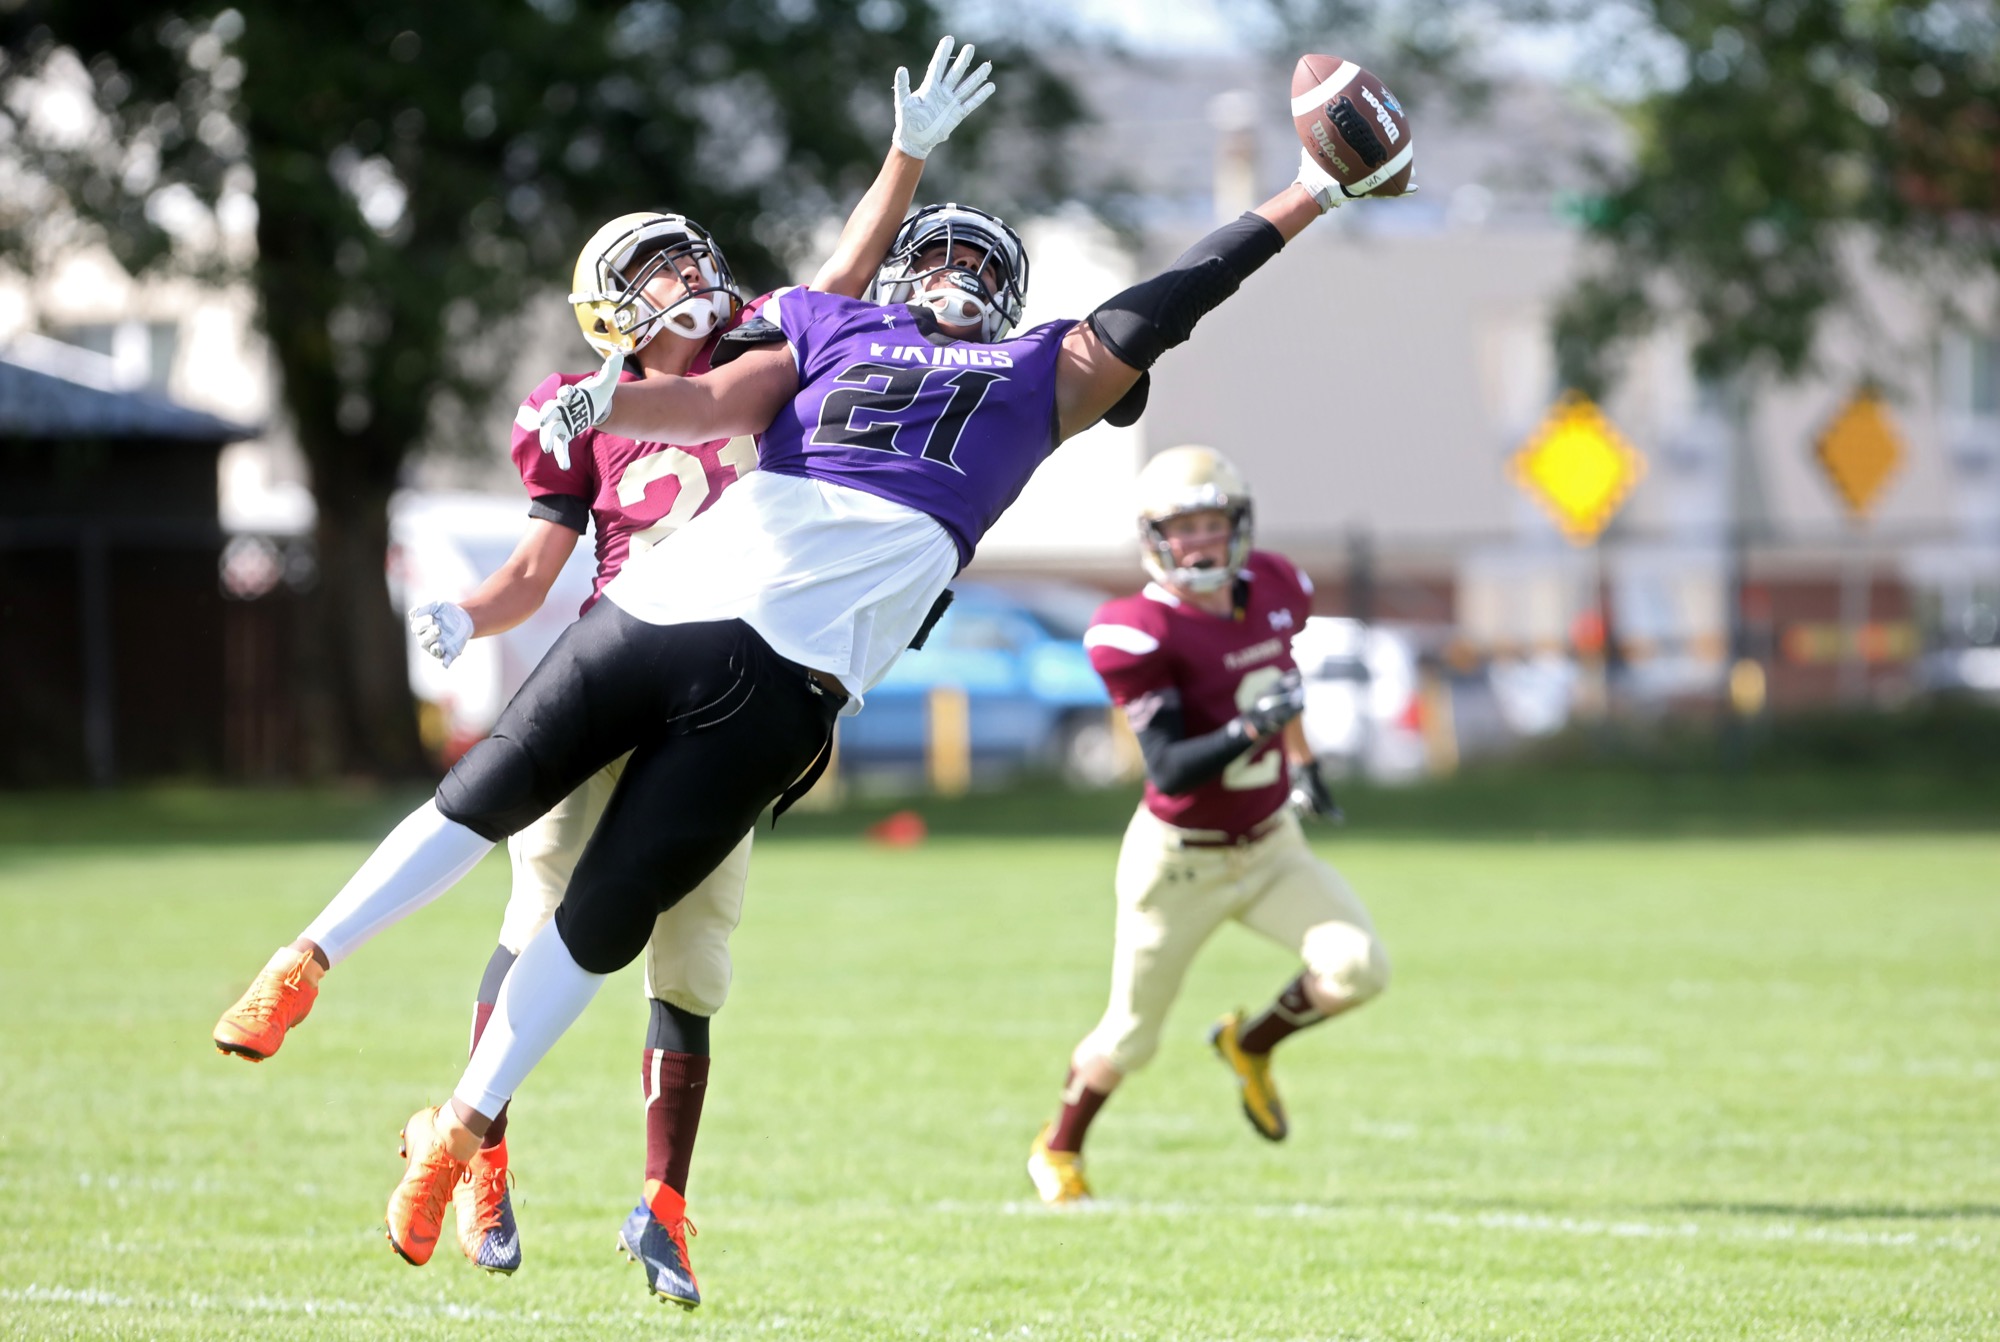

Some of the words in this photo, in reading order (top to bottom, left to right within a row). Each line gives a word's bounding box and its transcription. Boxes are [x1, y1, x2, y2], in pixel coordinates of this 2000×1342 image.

[1361, 85, 1400, 145] Wilson
[1311, 120, 1349, 175] Wilson
[870, 342, 1013, 368] VIKINGS
[809, 362, 1011, 476] 21
